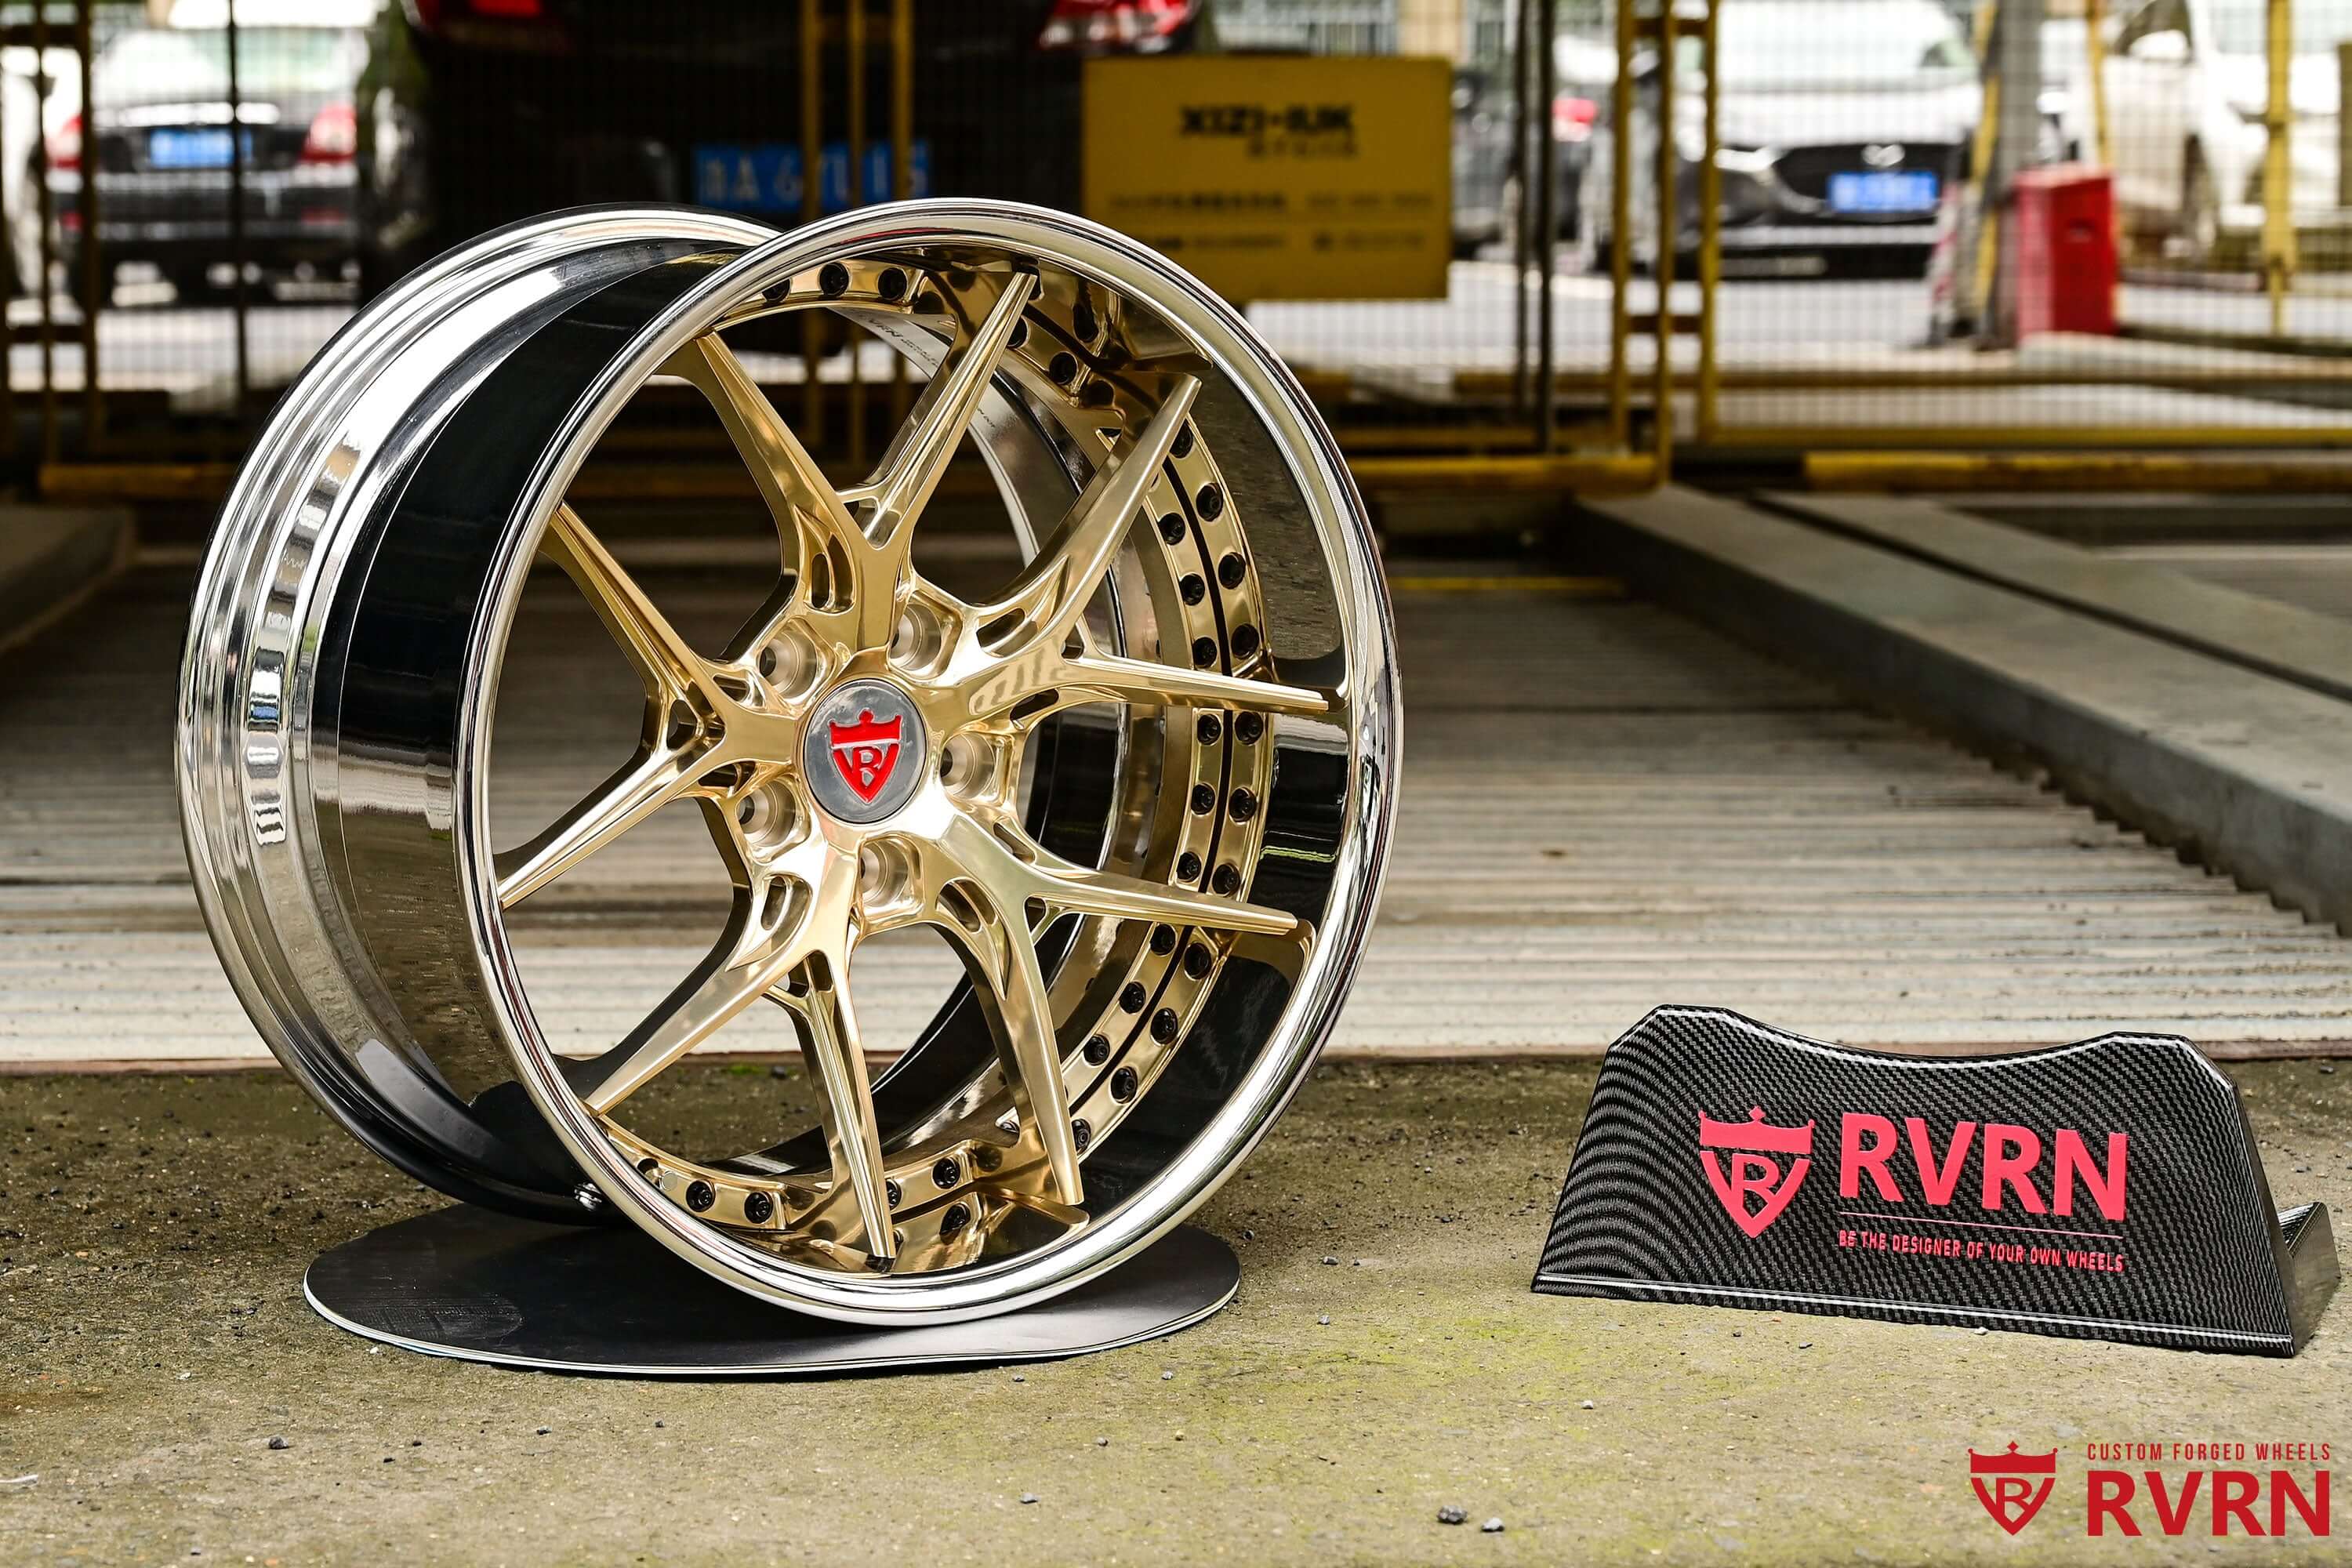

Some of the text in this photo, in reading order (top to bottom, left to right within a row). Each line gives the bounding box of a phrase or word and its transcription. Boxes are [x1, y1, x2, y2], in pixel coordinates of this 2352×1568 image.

[1839, 1112, 2128, 1221] RVRN
[1839, 1229, 2125, 1272] BE THE DESIGNER OF YOUR OWN WHEELS
